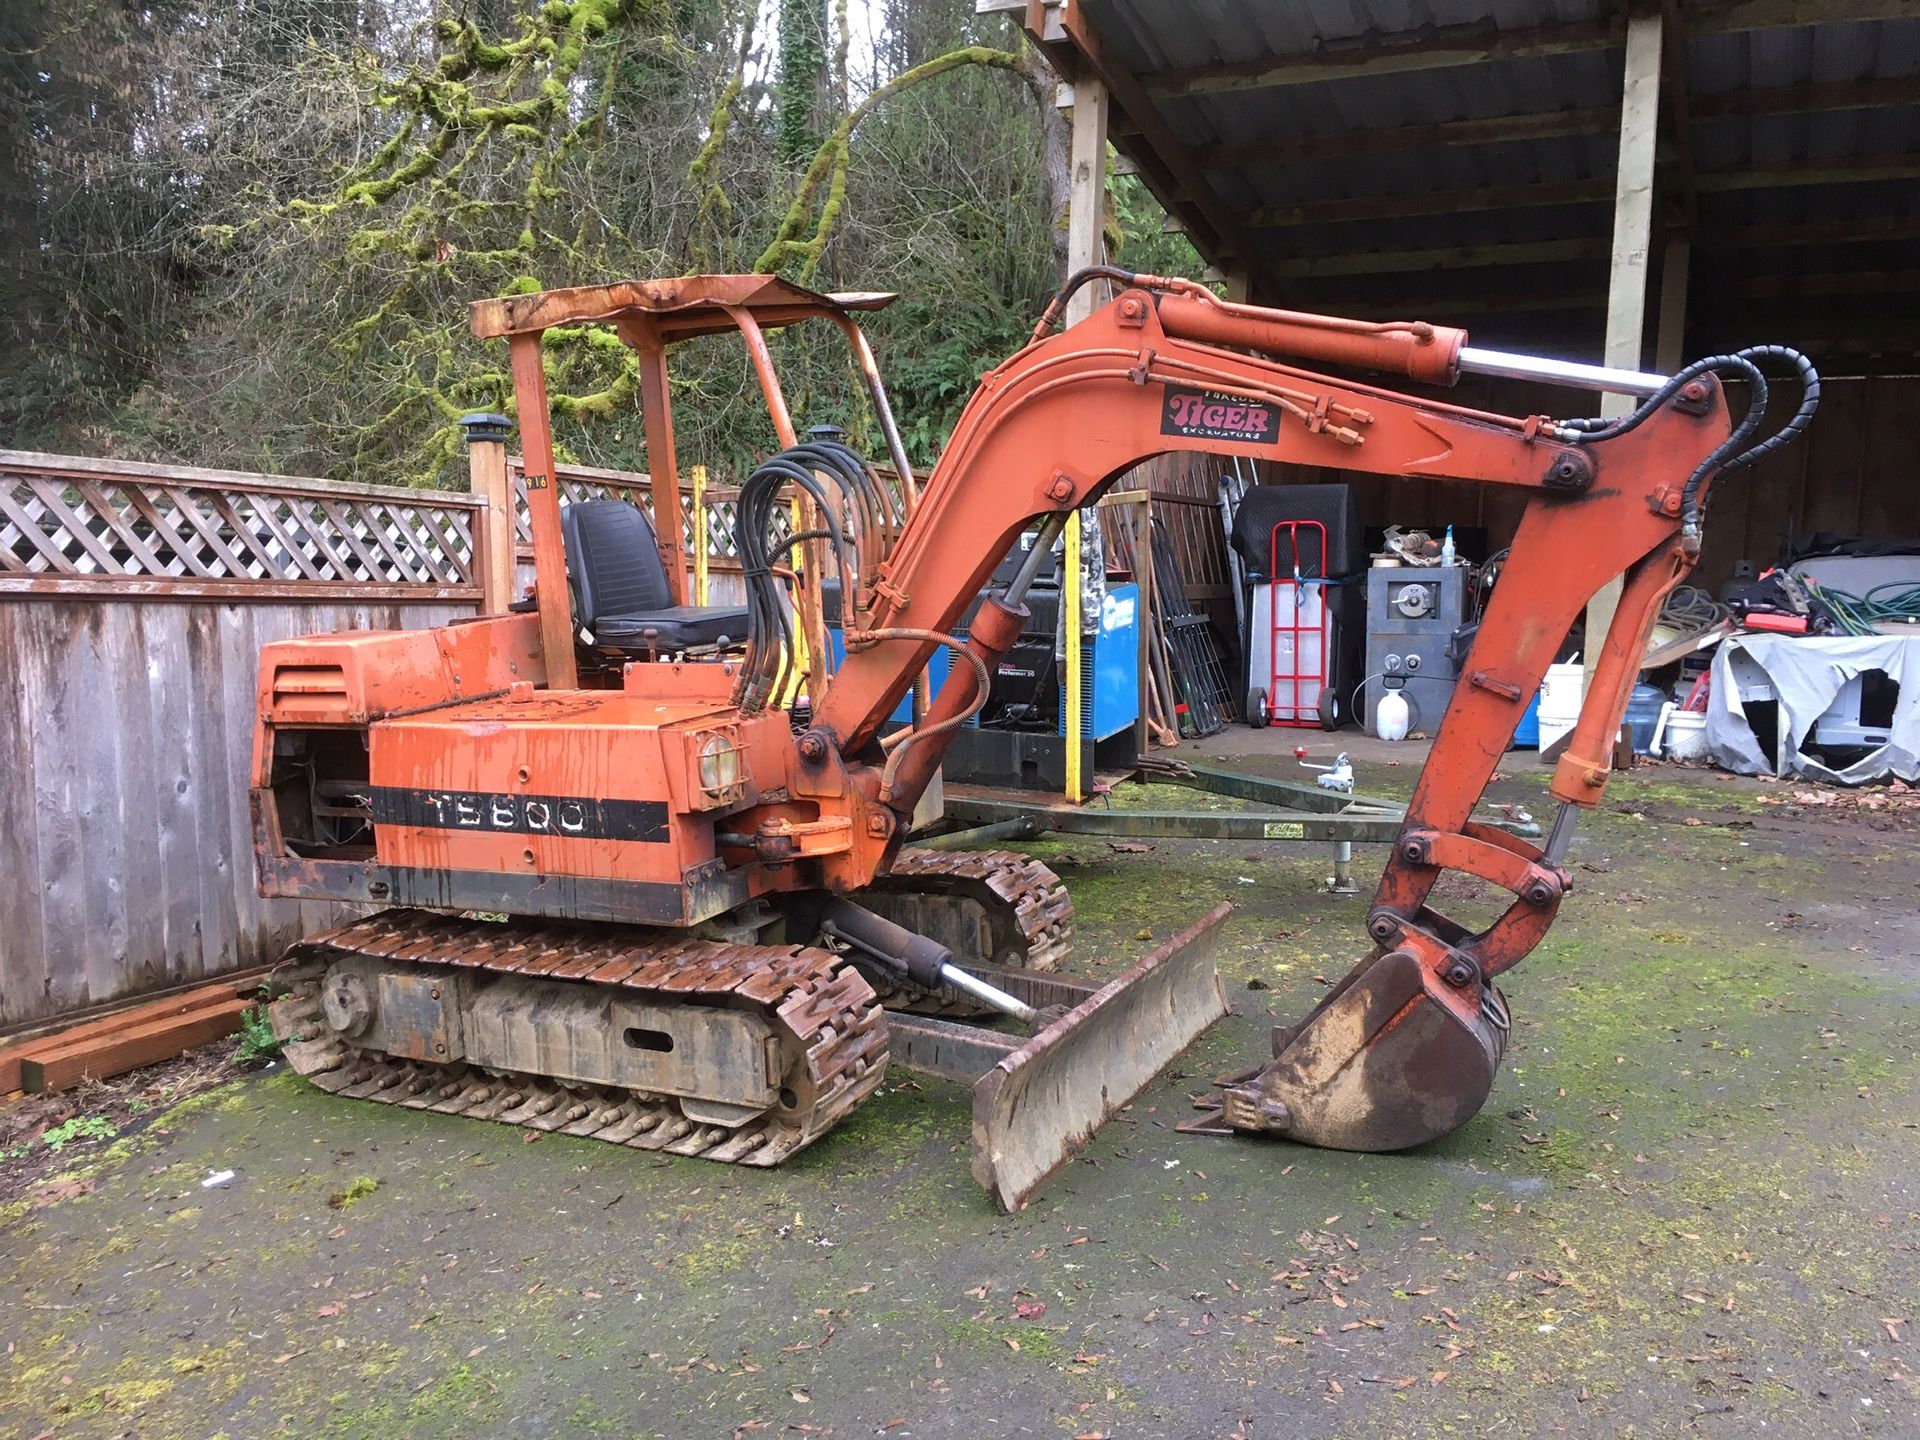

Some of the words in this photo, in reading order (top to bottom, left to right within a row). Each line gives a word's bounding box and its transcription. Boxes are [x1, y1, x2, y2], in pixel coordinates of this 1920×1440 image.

[1205, 390, 1268, 403] TAKEU
[1169, 393, 1269, 432] TIGER
[1182, 426, 1260, 440] EXCAVATORS
[526, 477, 547, 488] 916
